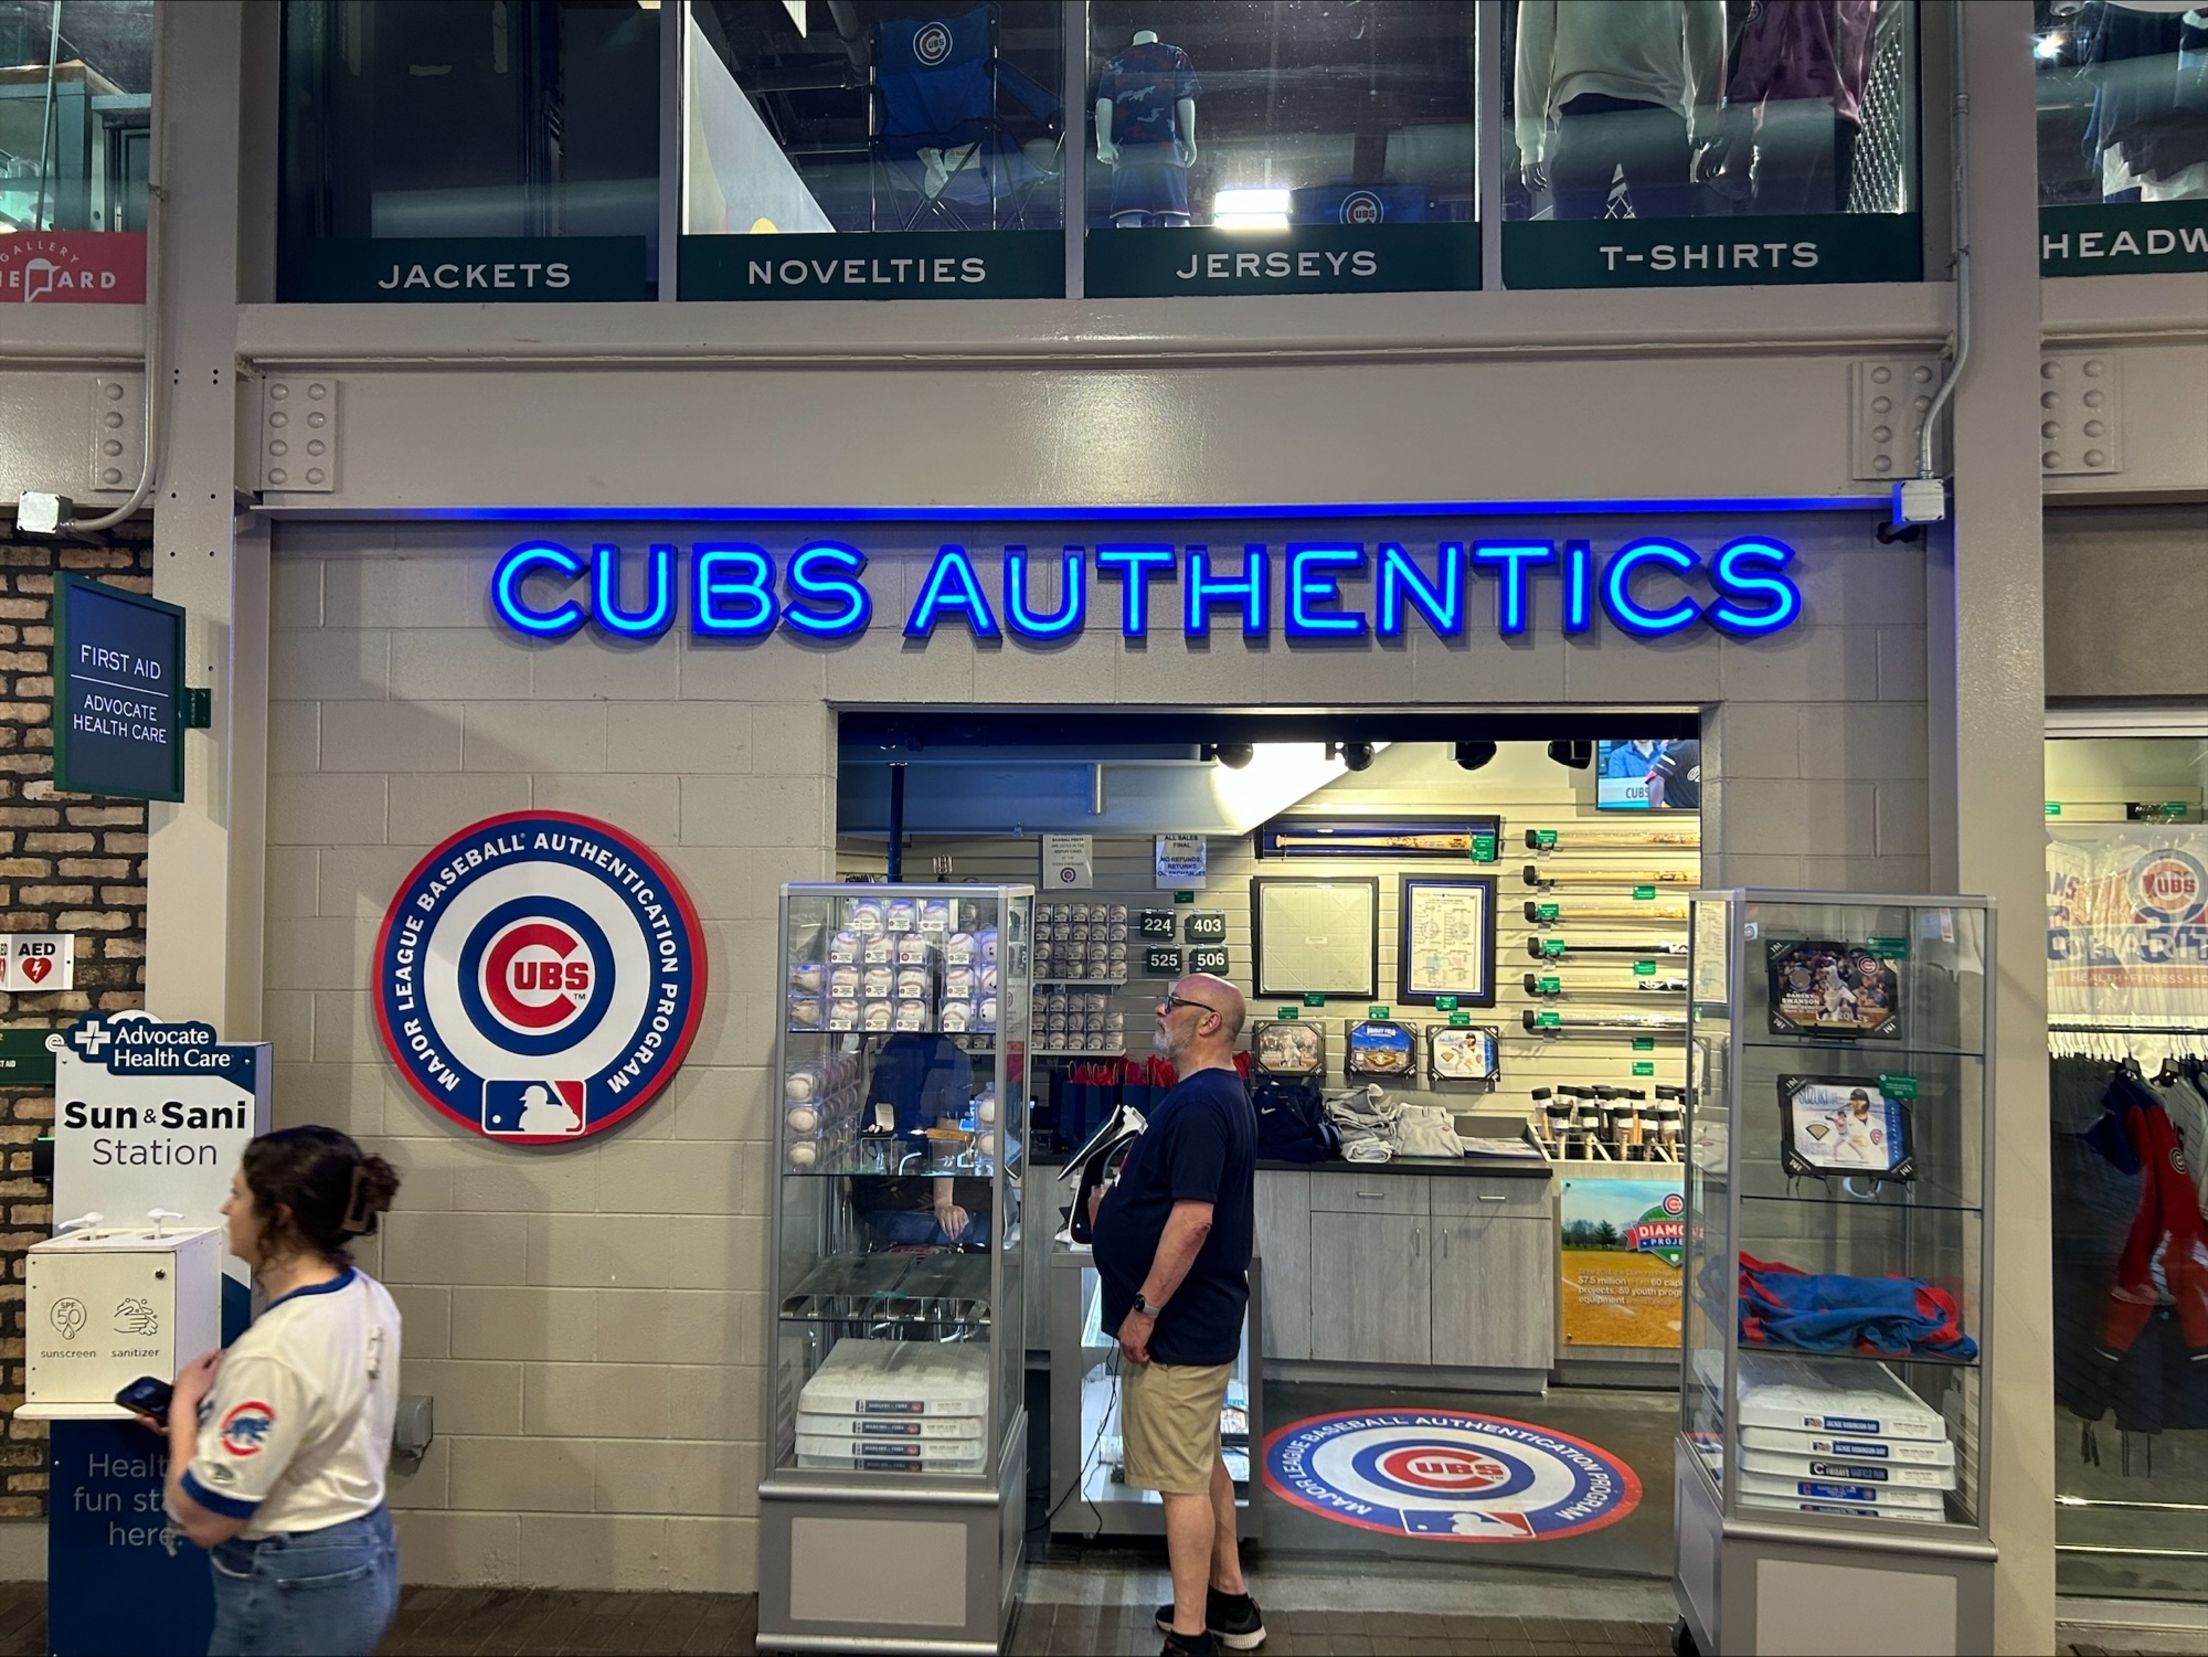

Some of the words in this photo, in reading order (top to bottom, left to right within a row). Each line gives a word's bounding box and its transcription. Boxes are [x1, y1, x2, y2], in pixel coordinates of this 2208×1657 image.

[0, 240, 79, 263] GALLERY
[1599, 241, 1820, 271] T-SHIRTS
[2042, 228, 2208, 260] HEADW
[377, 263, 571, 290] JACKETS
[748, 257, 986, 286] NOVELTIES
[1175, 250, 1378, 280] JERSEYS
[491, 538, 872, 638] CUBS
[902, 536, 1802, 642] AUTHENTICS
[81, 644, 129, 672] FIRST
[134, 658, 161, 680] AID
[84, 694, 157, 722] ADVOCATE
[73, 713, 128, 738] HEALTH
[132, 724, 167, 744] CARE
[533, 832, 679, 973] AUTHENTICATION
[1144, 918, 1171, 931] 224
[1194, 919, 1221, 933] 403
[18, 942, 55, 956] AED
[396, 915, 424, 1011] LEAGUE
[1151, 953, 1178, 967] 525
[1197, 952, 1225, 966] 506
[485, 923, 590, 1029] CUBS
[115, 1025, 209, 1045] Advocate
[606, 982, 679, 1094] PROGRAM
[114, 1049, 180, 1067] Health
[184, 1050, 231, 1068] Care
[404, 1018, 461, 1092] MAJOR
[64, 1101, 137, 1129] Sun
[143, 1108, 157, 1124] &
[161, 1100, 246, 1129] Sani
[93, 1138, 217, 1166] Station
[1650, 1238, 1684, 1247] PROJE
[57, 1308, 82, 1325] 50
[41, 1349, 96, 1359] sunscreen
[111, 1348, 160, 1359] sanitizer
[1300, 1416, 1410, 1443] BASEBALL
[1415, 1416, 1604, 1473] AUTHENTICATION
[88, 1453, 170, 1478] Healt
[1282, 1440, 1311, 1480] LEAGUE
[1382, 1448, 1505, 1489] CUBS
[73, 1486, 121, 1512] fun
[133, 1488, 163, 1512] st
[1295, 1478, 1373, 1515] MAJOR
[1555, 1472, 1612, 1521] PROGRAM
